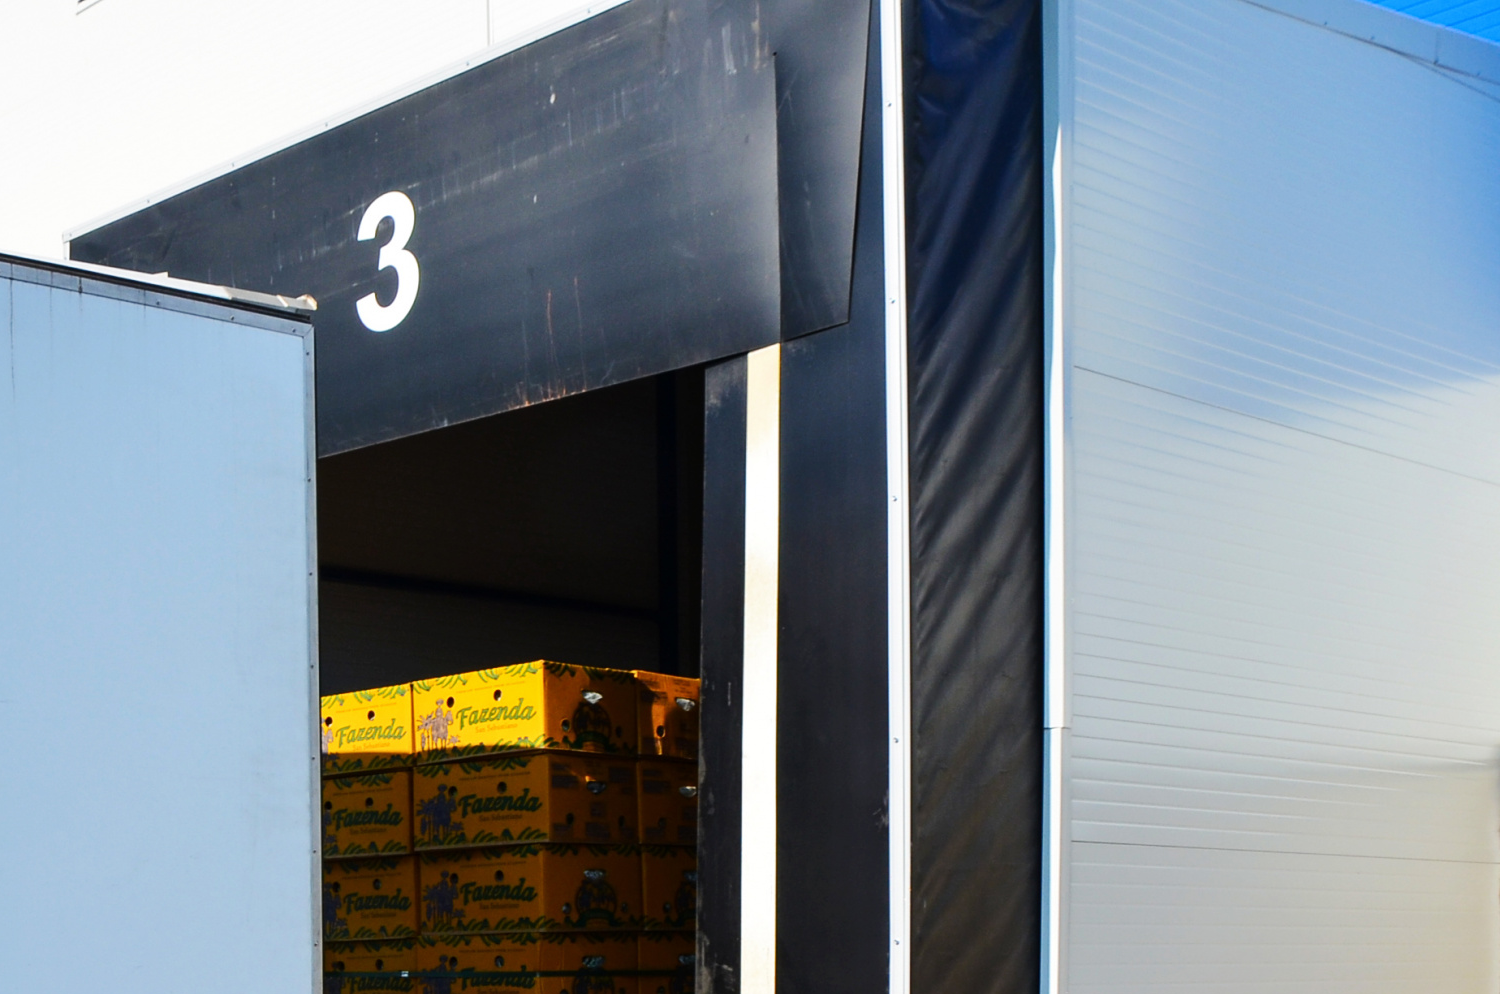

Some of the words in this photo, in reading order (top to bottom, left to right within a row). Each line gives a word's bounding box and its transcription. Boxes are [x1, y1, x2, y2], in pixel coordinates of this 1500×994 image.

[356, 190, 421, 333] 3
[456, 698, 537, 731] Fazenda
[335, 718, 407, 748] Fazenda
[332, 803, 403, 831] Fazenda
[458, 788, 543, 819] Fazenda
[344, 888, 412, 915] Fazenda
[460, 877, 538, 906] Fazenda
